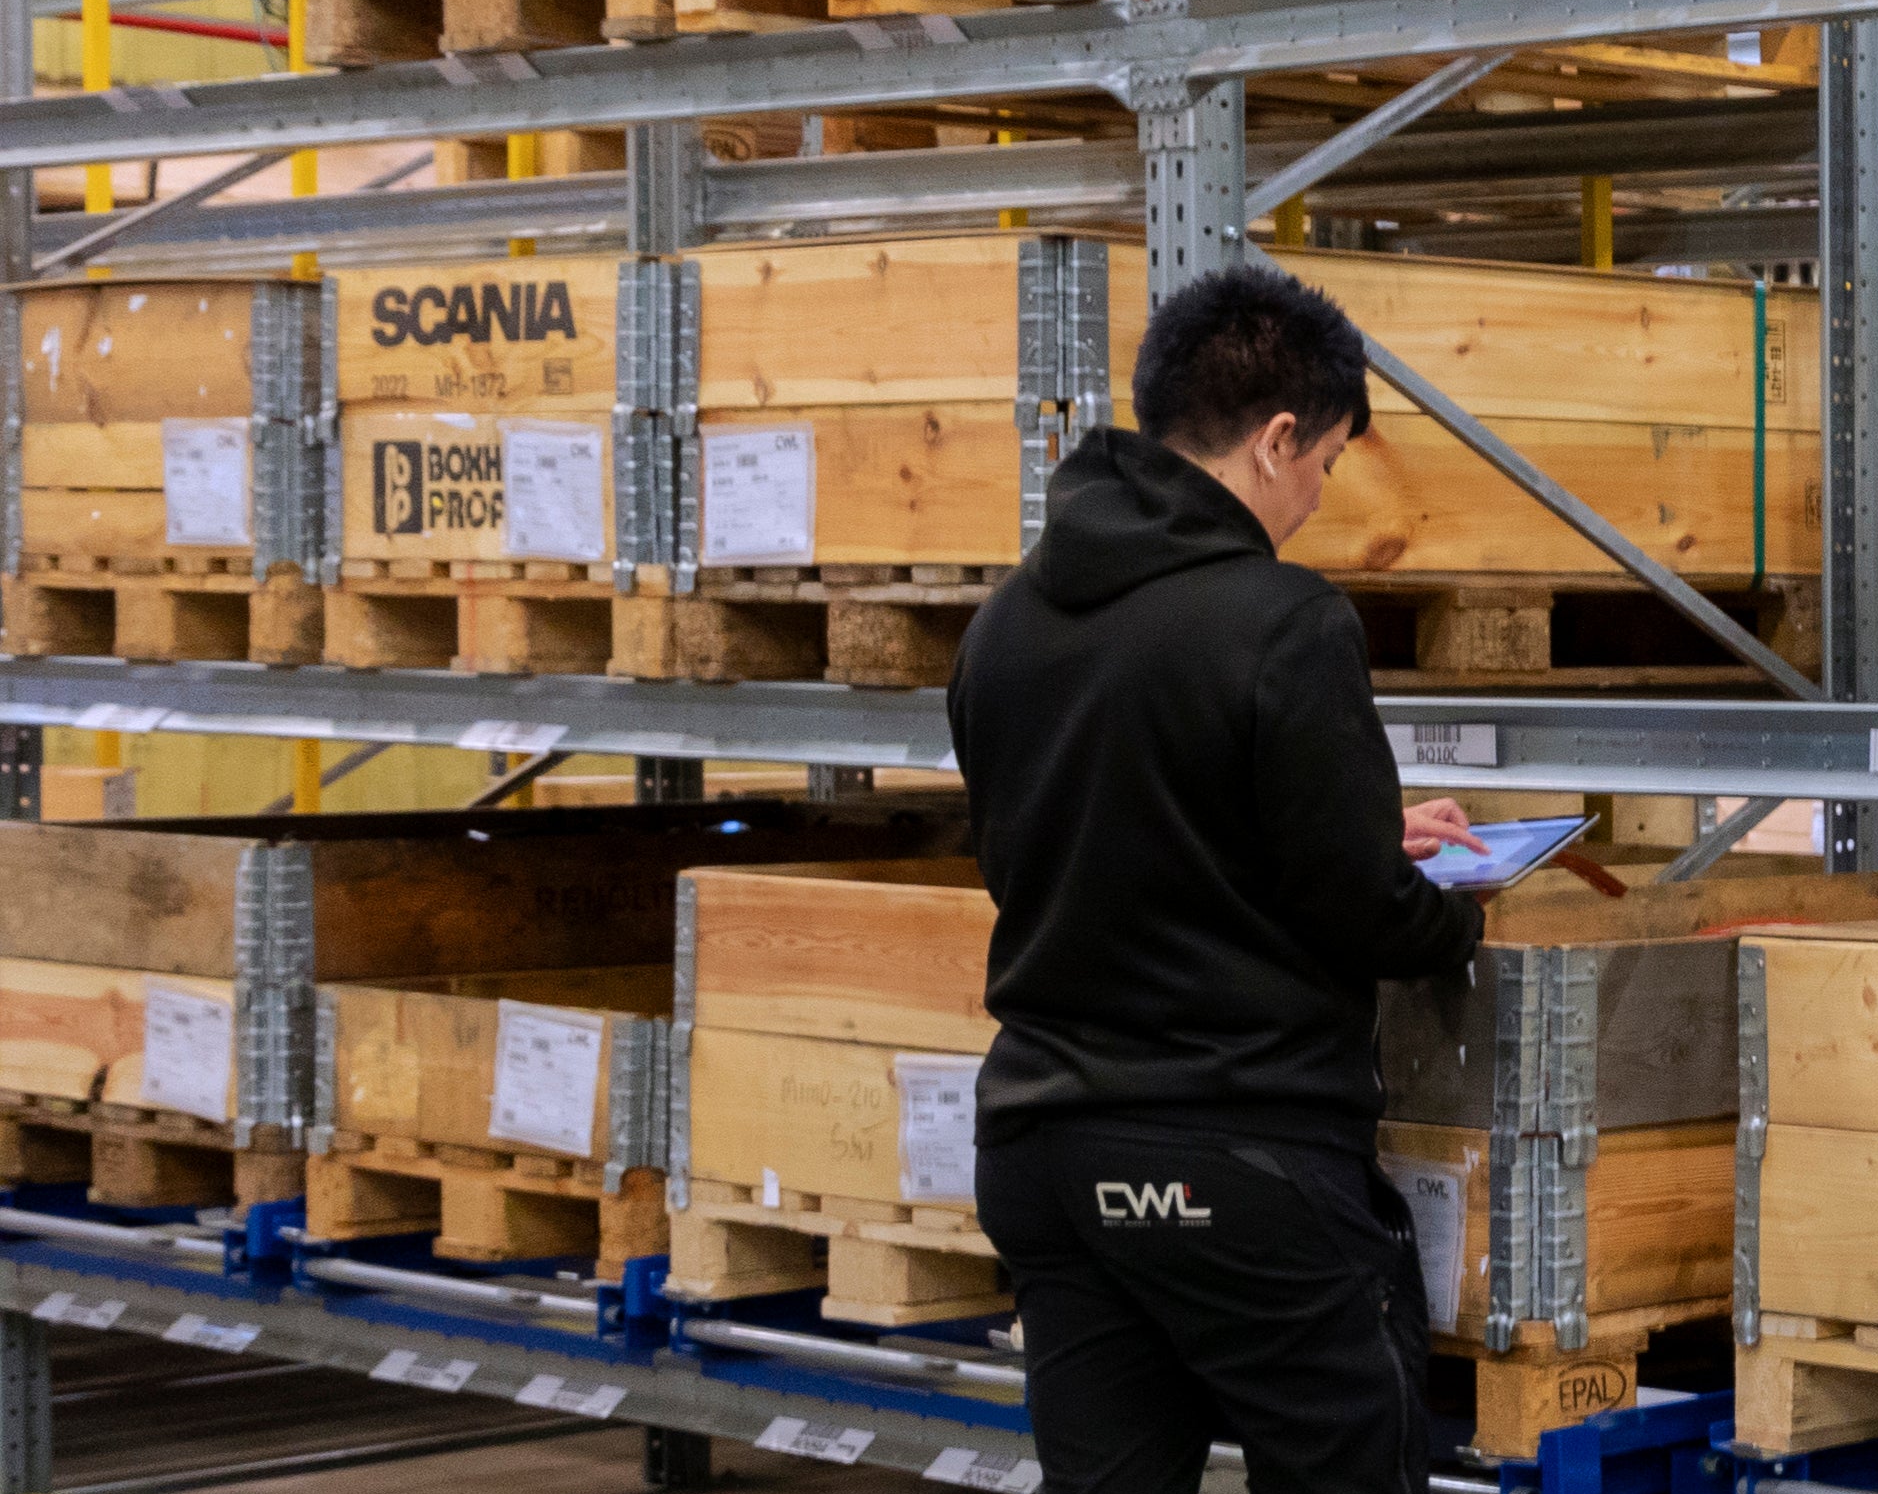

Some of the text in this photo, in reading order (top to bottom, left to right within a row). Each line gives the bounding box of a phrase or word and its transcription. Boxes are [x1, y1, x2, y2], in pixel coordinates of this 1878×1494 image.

[371, 281, 577, 347] SCANIA
[1416, 746, 1458, 765] BQ10C
[1096, 1181, 1211, 1219] CWL
[1417, 1177, 1450, 1199] CWL
[1559, 1372, 1615, 1411] EPAL
